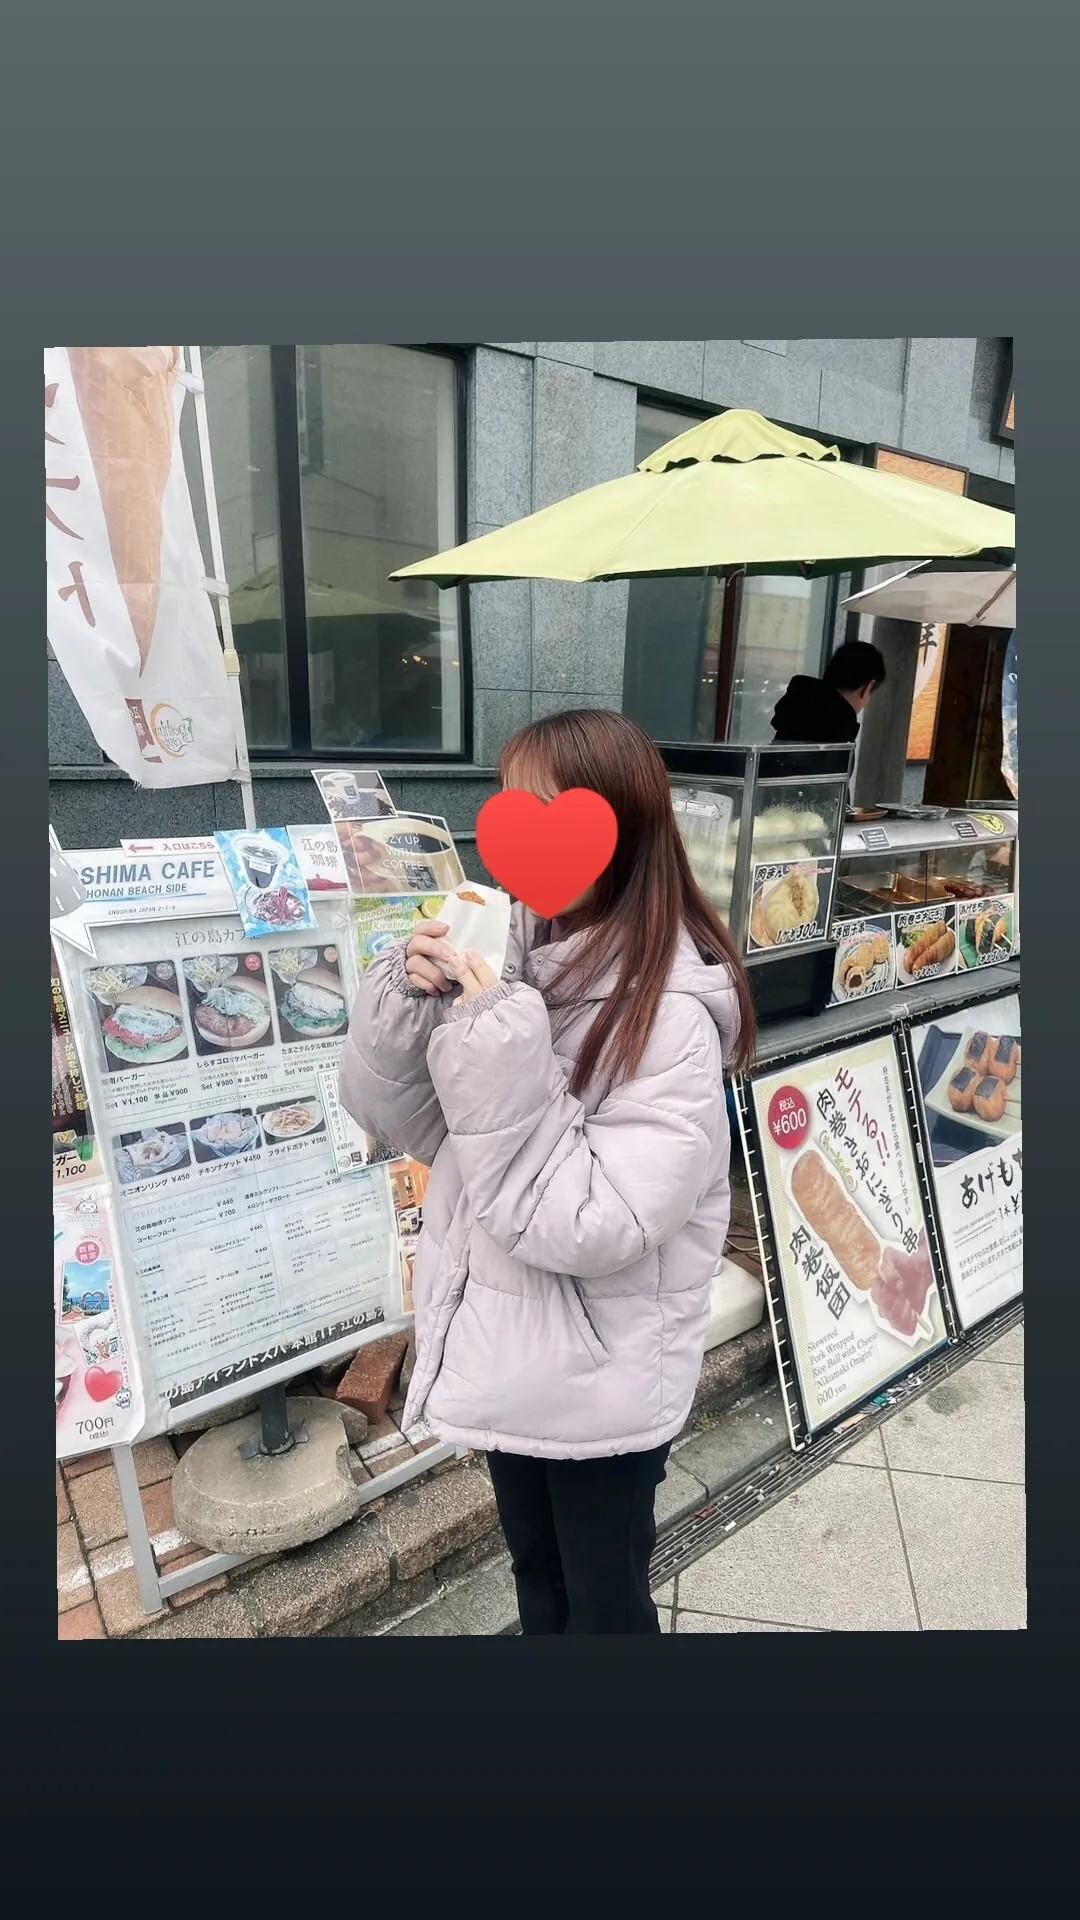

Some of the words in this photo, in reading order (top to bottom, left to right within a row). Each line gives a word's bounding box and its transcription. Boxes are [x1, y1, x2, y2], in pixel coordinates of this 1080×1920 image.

[163, 842, 215, 851] 入口はこちら
[302, 838, 338, 853] 江の島
[405, 835, 419, 846] UP
[311, 855, 338, 868] 珈琲
[80, 863, 152, 885] SHIMA
[161, 860, 215, 880] CAFE
[756, 865, 784, 881] 肉まん
[86, 888, 124, 899] HONAN
[128, 884, 162, 896] BEACH
[166, 883, 188, 893] SIDE
[197, 1053, 265, 1068] しらすコロッケバーガー
[201, 1082, 213, 1090] Set
[252, 1073, 268, 1081] ¥700
[122, 1096, 148, 1106] ¥1,100
[170, 1088, 188, 1097] ¥900
[778, 1096, 797, 1112] 税込
[773, 1108, 807, 1136] ¥600
[267, 1141, 309, 1157] フライドポテト
[56, 1164, 86, 1179] 1,100
[199, 1159, 240, 1175] チキンナゲット
[243, 1154, 261, 1164] ¥450
[120, 1178, 168, 1197] オニオンリング
[171, 1173, 190, 1184] ¥450
[808, 1326, 838, 1353] Skewered
[810, 1350, 826, 1365] Pork
[826, 1330, 855, 1354] Wrapped
[812, 1365, 827, 1378] Rice
[827, 1353, 841, 1369] Ball
[842, 1344, 857, 1359] with
[817, 1387, 834, 1405] 600
[834, 1383, 847, 1398] yen
[75, 1416, 114, 1435] 700円
